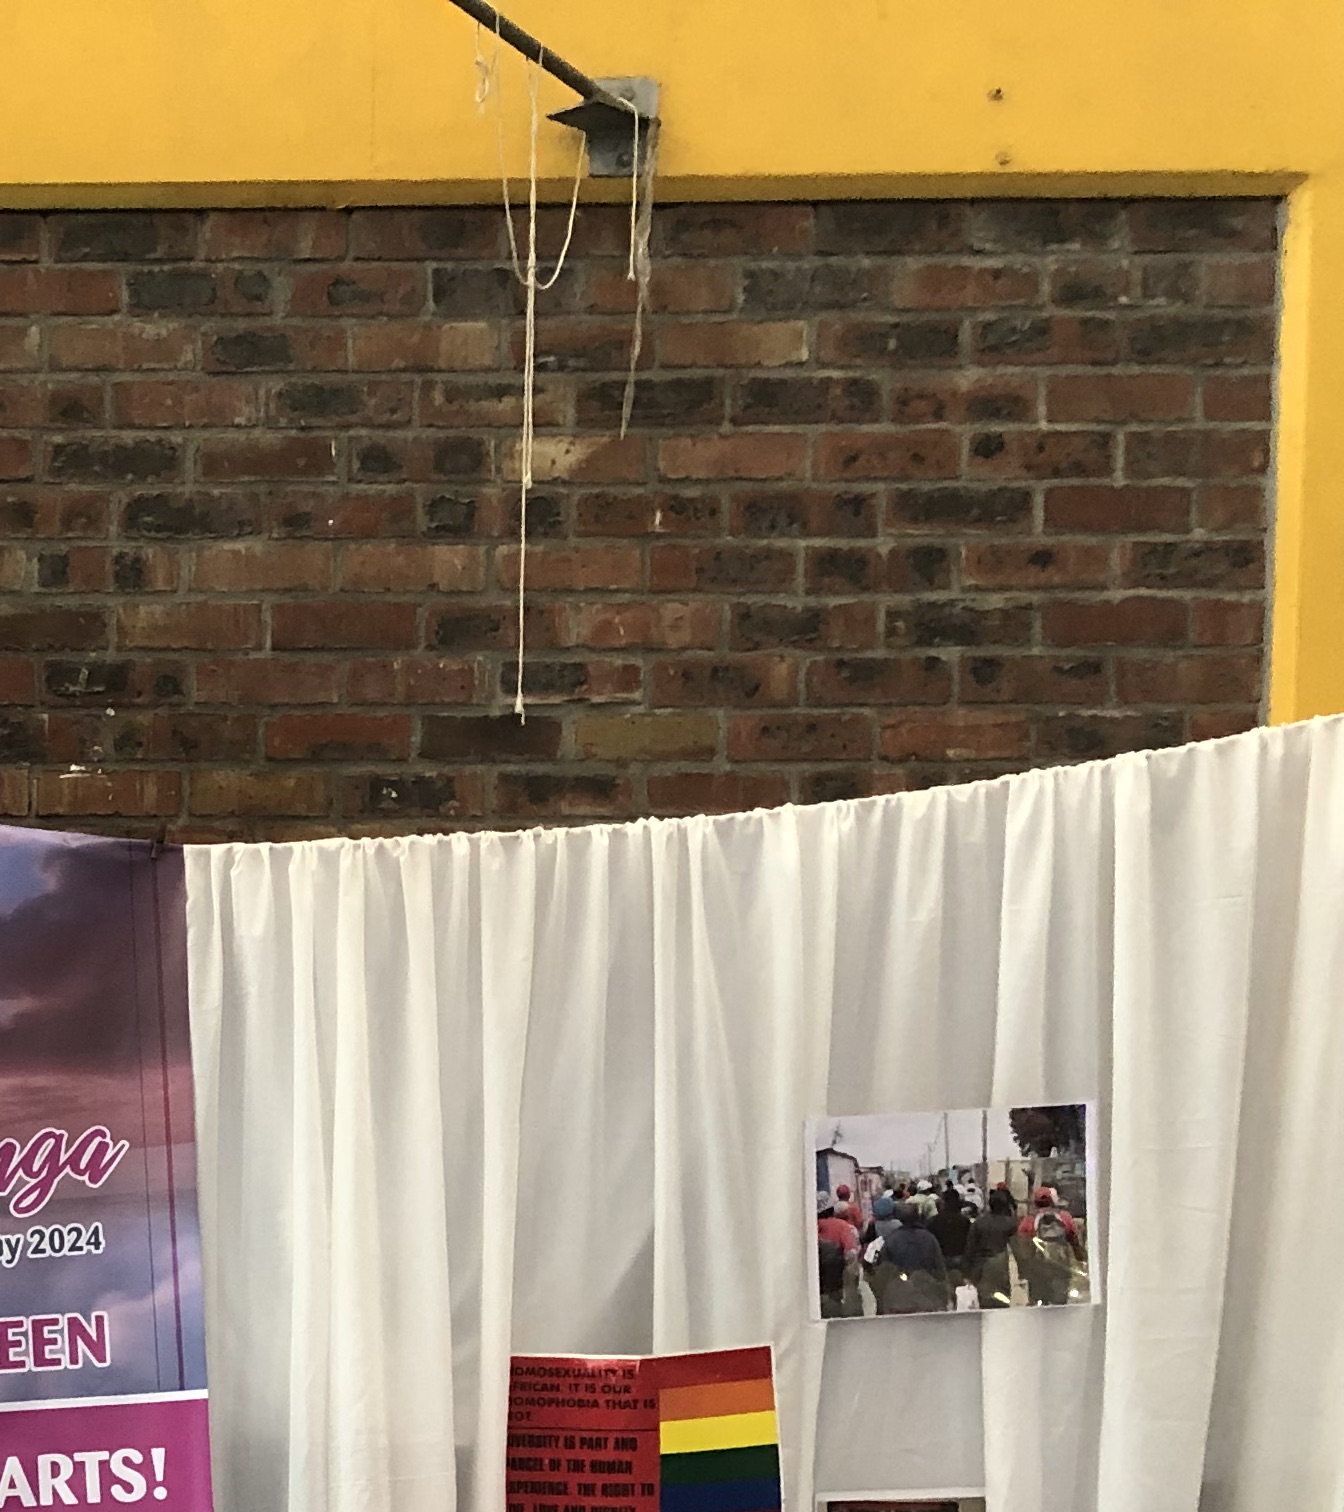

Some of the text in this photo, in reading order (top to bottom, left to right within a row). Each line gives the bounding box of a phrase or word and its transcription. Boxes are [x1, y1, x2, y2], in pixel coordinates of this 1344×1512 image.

[28, 1225, 103, 1257] 2024
[622, 1369, 635, 1380] IS
[568, 1382, 580, 1393] IT
[584, 1383, 596, 1394] IS
[601, 1383, 632, 1394] OUR
[604, 1398, 638, 1411] THAT
[643, 1398, 657, 1409] IS
[564, 1436, 576, 1450] IS
[579, 1436, 609, 1451] PART
[613, 1436, 638, 1452] AND
[548, 1458, 561, 1472] OF
[566, 1459, 586, 1474] THE
[589, 1459, 633, 1475] HUMAN
[577, 1482, 597, 1497] THE
[640, 1483, 655, 1497] TO
